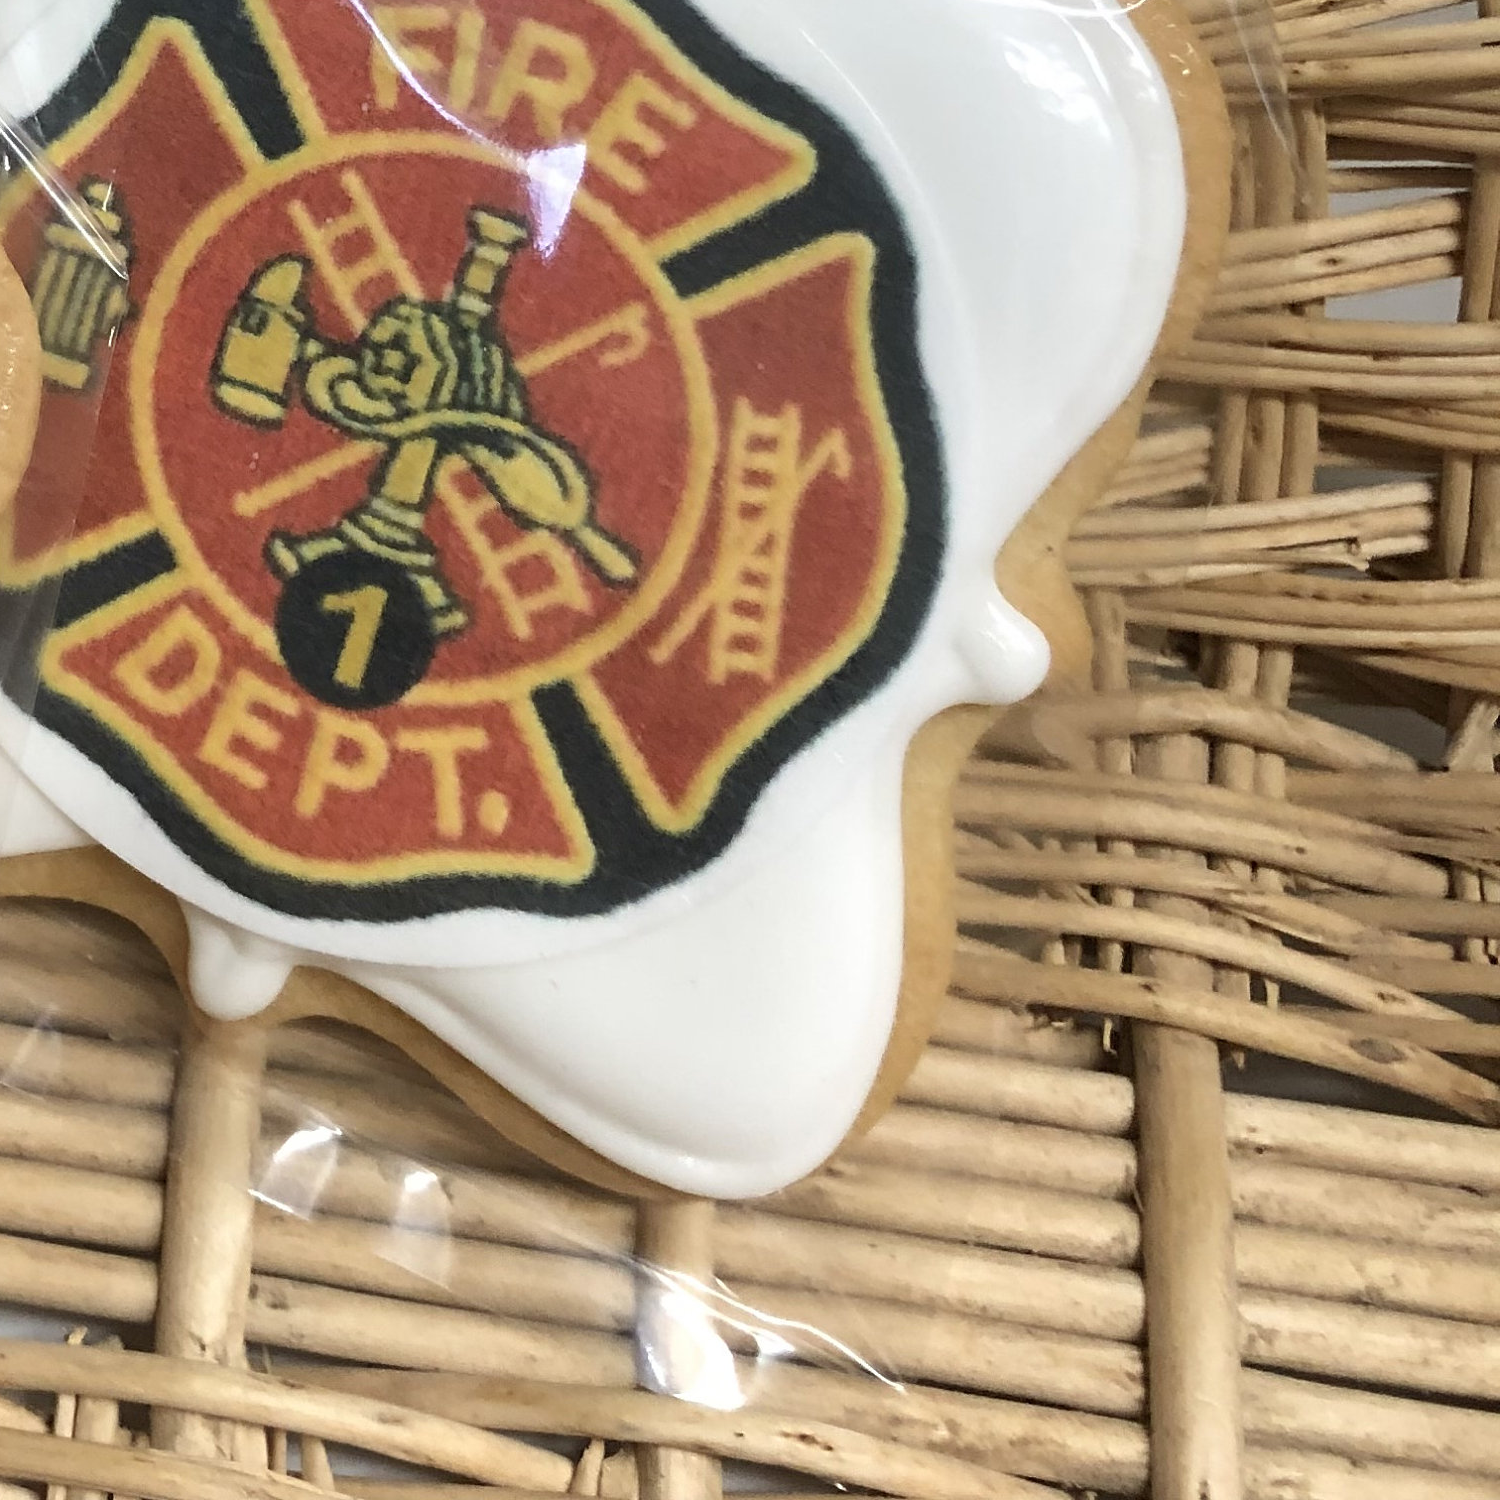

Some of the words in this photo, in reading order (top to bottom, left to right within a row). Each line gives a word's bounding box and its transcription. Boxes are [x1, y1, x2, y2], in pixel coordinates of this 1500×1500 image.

[367, 4, 697, 194] FIRE
[112, 605, 509, 838] DEPT.
[322, 584, 391, 688] 1
